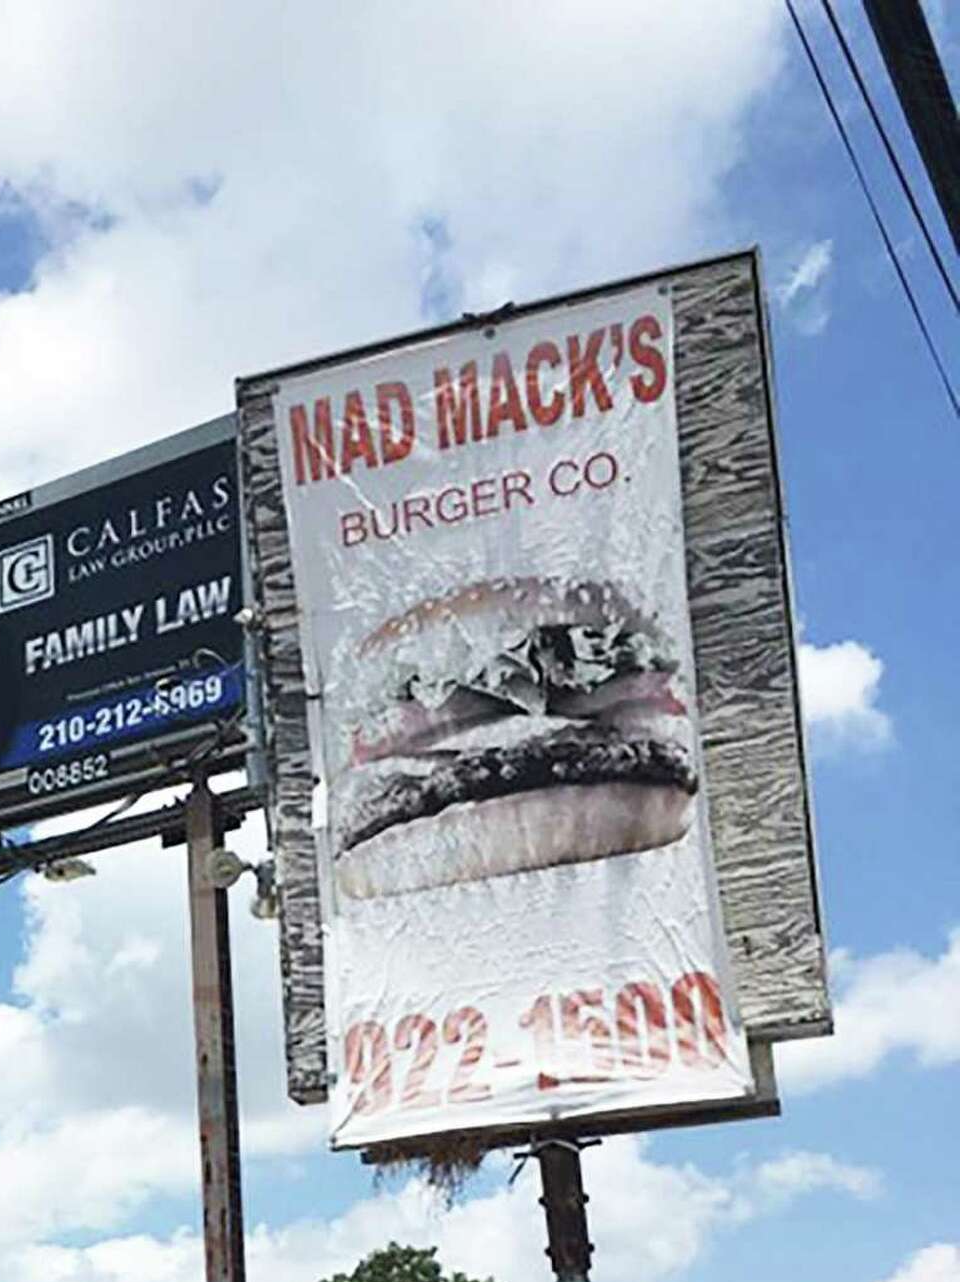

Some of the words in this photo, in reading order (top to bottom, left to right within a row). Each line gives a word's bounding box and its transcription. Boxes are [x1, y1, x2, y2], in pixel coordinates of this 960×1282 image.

[289, 380, 416, 486] MAD
[435, 314, 668, 452] MACK'S
[66, 475, 230, 557] CALFAS
[341, 471, 534, 548] BURGER
[548, 451, 632, 497] CO.
[67, 556, 107, 583] LAW
[24, 605, 145, 676] FAMILY
[154, 577, 234, 631] LAW
[27, 754, 109, 794] 008852
[343, 970, 728, 1116] 922-1500
